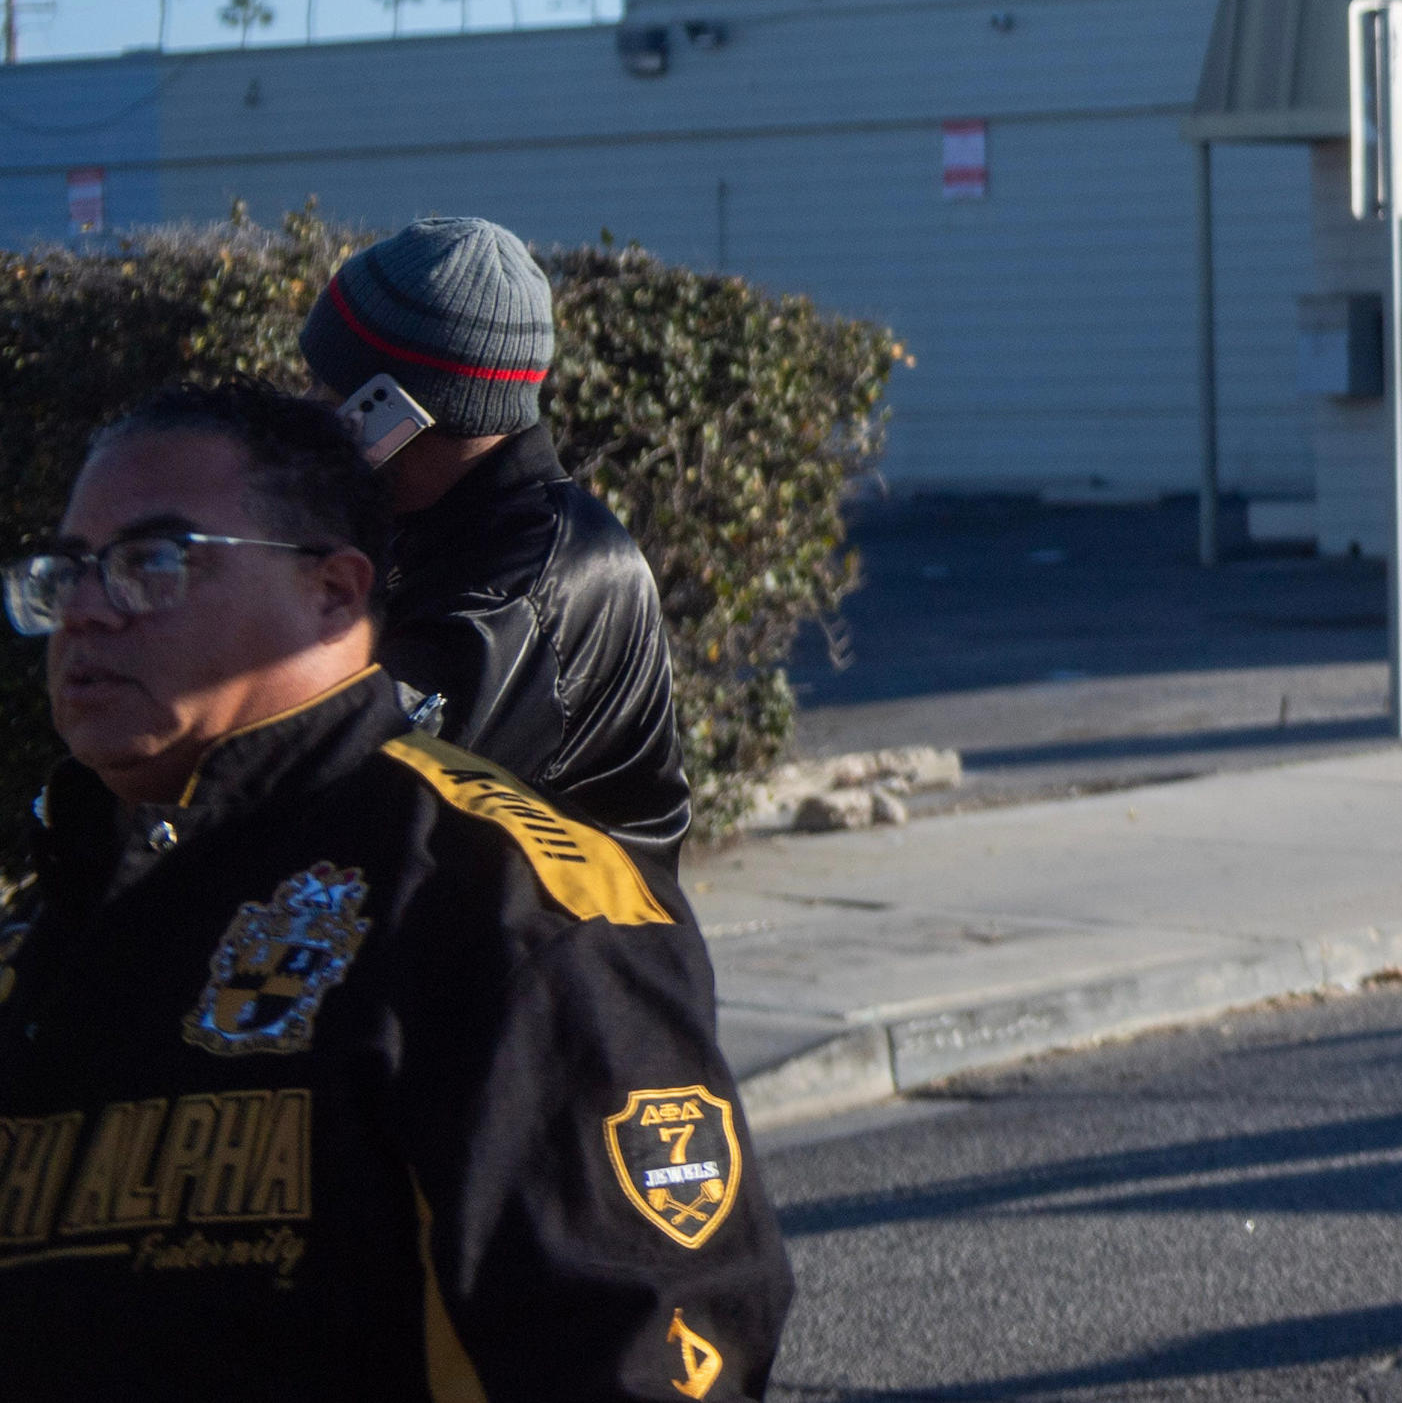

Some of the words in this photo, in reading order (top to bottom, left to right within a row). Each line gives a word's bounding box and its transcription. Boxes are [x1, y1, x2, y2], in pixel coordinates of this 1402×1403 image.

[658, 1123, 696, 1165] 7
[0, 1111, 84, 1245] HI
[58, 1088, 311, 1235] ALPHA
[645, 1160, 721, 1188] JEWELS
